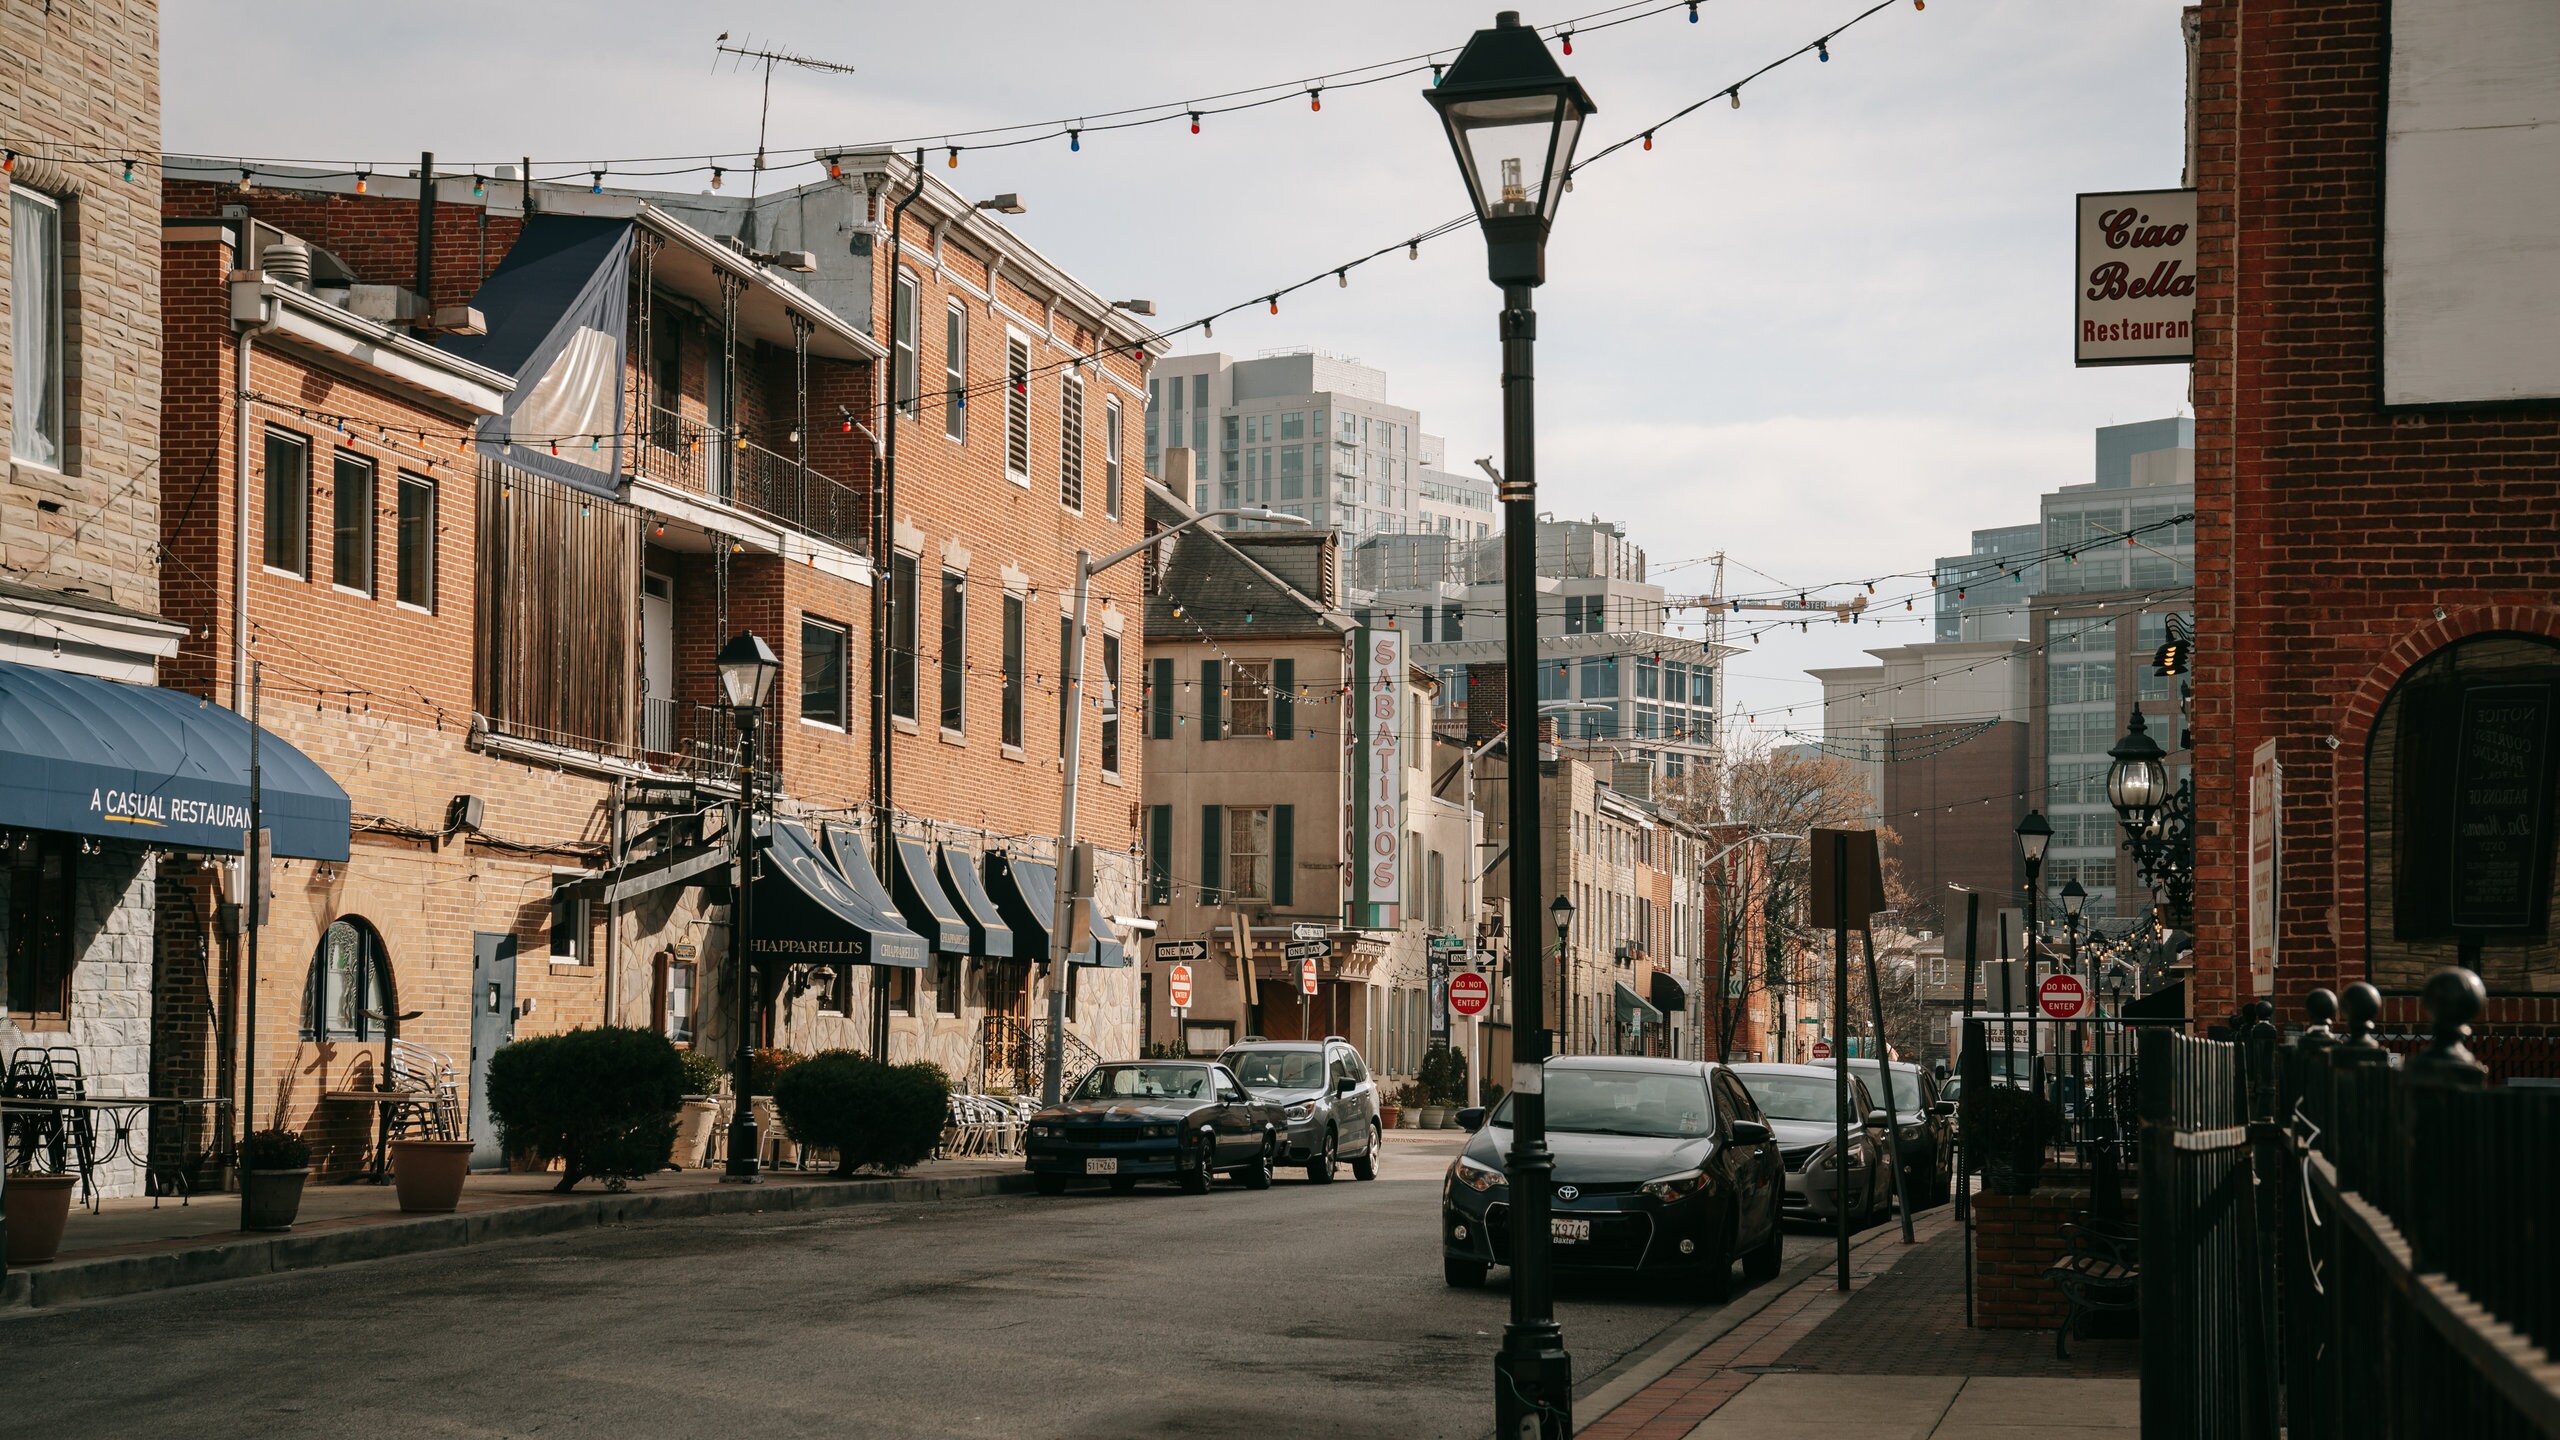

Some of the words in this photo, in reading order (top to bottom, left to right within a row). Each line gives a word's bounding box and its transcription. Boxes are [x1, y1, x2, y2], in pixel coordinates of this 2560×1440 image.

[2098, 207, 2189, 250] Ciao
[2087, 260, 2196, 301] Bella
[2083, 318, 2193, 342] Restauran
[90, 788, 101, 811] A
[106, 790, 166, 819] CASUAL
[171, 799, 262, 829] RESTAURAN
[750, 939, 863, 955] HIAPPARELLI'S
[1160, 948, 1175, 956] ONE
[1180, 947, 1195, 955] WAY
[1289, 948, 1303, 956] ONE
[2049, 1002, 2075, 1010] ENTER
[1552, 1223, 1588, 1238] K9743
[1553, 1236, 1576, 1244] Baxter
